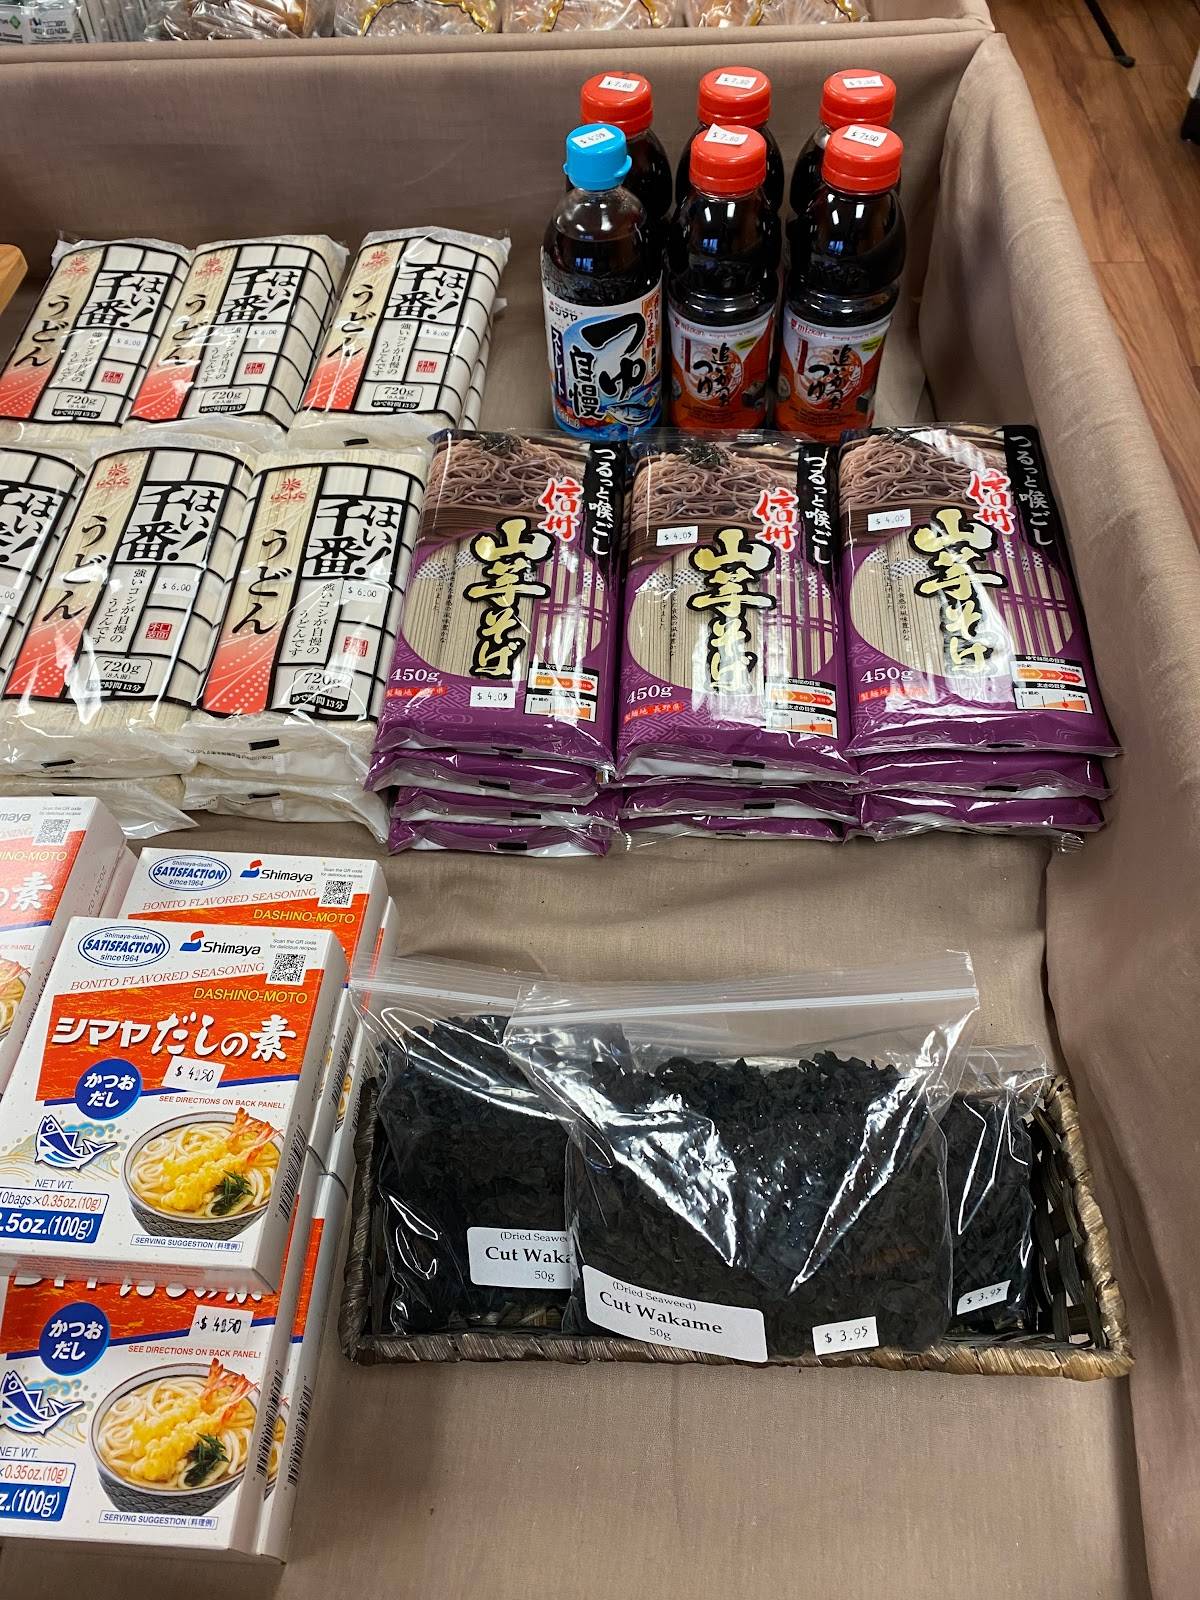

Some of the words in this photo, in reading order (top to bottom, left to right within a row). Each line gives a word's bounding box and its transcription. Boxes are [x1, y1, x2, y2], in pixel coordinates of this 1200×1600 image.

[14, 294, 70, 367] うどん
[66, 394, 98, 406] 720g
[212, 391, 242, 400] 720g
[383, 386, 414, 397] 720g
[1009, 434, 1054, 547] つるっと喉ごし
[539, 479, 583, 541] 信州
[588, 448, 617, 556] つるっと喉ごし
[803, 455, 832, 565] つるっと喉ごし
[969, 469, 1014, 535] 信州
[756, 488, 798, 551] 信州
[170, 583, 191, 592] 6.00
[231, 529, 293, 635] うどん
[912, 507, 1005, 674] 山芋そば
[0, 590, 15, 601] .00
[357, 588, 377, 598] 6.00
[465, 517, 553, 677] 山芋そば
[109, 568, 147, 643] 強いコシが自慢の
[92, 598, 118, 645] うどんです
[103, 660, 142, 675] 720g
[390, 668, 441, 683] 450g
[860, 666, 914, 684] 450g
[626, 684, 674, 704] 450g
[0, 811, 32, 824] maya
[0, 850, 68, 863] INO-MOTO
[152, 864, 224, 881] SATISFACTION
[260, 869, 313, 883] Shimaya
[143, 899, 186, 911] BONITO
[189, 894, 249, 908] FLAVORED
[252, 887, 317, 902] SEASONING
[253, 909, 356, 924] DASHINO-MOTO
[104, 932, 150, 941] Shimaya-dashi
[83, 938, 162, 956] SATISFACTION
[202, 941, 261, 956] Shimaya
[71, 977, 119, 991] BONITO
[122, 970, 190, 987] FLAVORED
[193, 962, 265, 979] SEASONING
[193, 987, 308, 1004] DASHINO-MOTO
[175, 1065, 182, 1078] $
[84, 1072, 137, 1089] かつお
[86, 1091, 120, 1109] だし
[159, 1095, 174, 1103] SEE
[175, 1096, 221, 1106] DIRECTIONS
[222, 1098, 233, 1106] ON
[234, 1099, 256, 1108] BACK
[257, 1101, 286, 1110] PANEL!
[34, 1179, 56, 1188] NET
[57, 1180, 74, 1190] WT.
[0, 1212, 94, 1241] .5oz.(100g)
[135, 1237, 167, 1246] SERVING
[168, 1238, 214, 1249] SUGGESTION
[500, 1231, 531, 1242] (Dried
[533, 1233, 568, 1243] Seawee
[485, 1246, 518, 1261] Cut
[523, 1248, 572, 1264] Waka
[534, 1270, 556, 1283] 50g
[612, 1280, 644, 1300] (Dried
[645, 1291, 698, 1312] Seaweed)
[599, 1290, 632, 1315] Cut
[635, 1303, 724, 1335] Wakame
[48, 1320, 104, 1339] かつお
[649, 1326, 672, 1342] 50g
[824, 1333, 833, 1344] $
[839, 1326, 868, 1342] 3.95
[51, 1341, 86, 1361] だし
[128, 1345, 145, 1353] SEE
[146, 1346, 193, 1356] DIRECTIONS
[195, 1348, 207, 1356] ON
[209, 1349, 230, 1358] BACK
[232, 1350, 262, 1359] PANEL!
[21, 1447, 38, 1459] WT.
[0, 1464, 68, 1484] 0.35oz.(10g)
[0, 1489, 60, 1518] z.(100g)
[103, 1513, 137, 1523] SERVING
[138, 1514, 187, 1526] SUGGESTION
